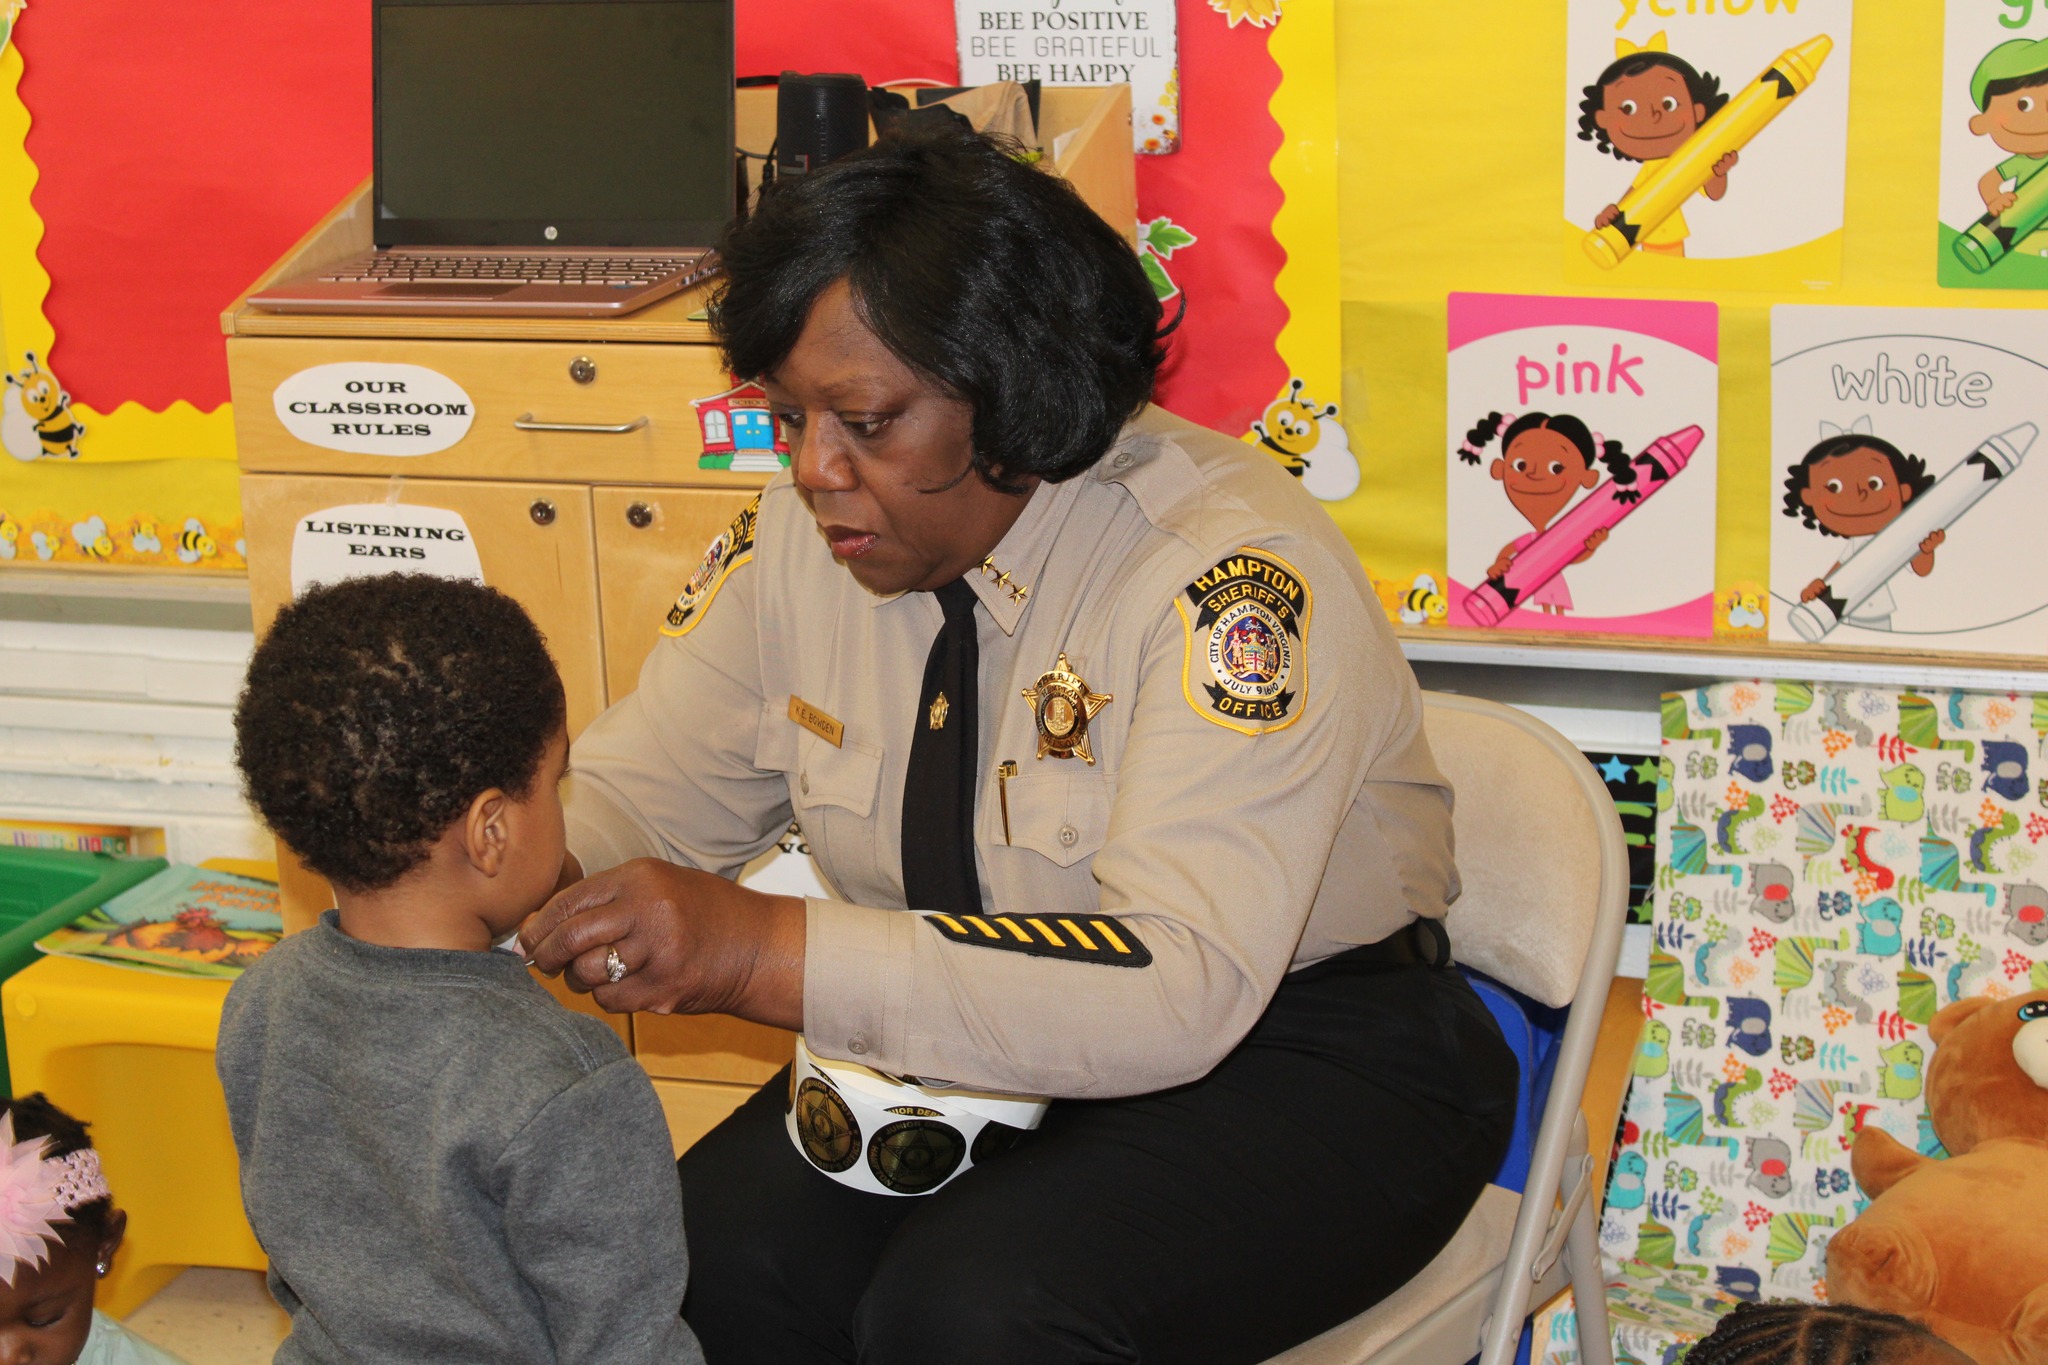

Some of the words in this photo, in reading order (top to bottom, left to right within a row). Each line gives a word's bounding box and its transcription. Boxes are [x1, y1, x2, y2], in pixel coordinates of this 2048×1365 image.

[979, 11, 1024, 30] BEE
[1032, 11, 1149, 30] POSITIVE
[971, 36, 1016, 57] BEE
[1034, 36, 1162, 58] GRATEFUL
[997, 63, 1041, 82] BEE
[1049, 63, 1136, 83] HAPPY
[1515, 342, 1645, 406] pink
[1831, 352, 1993, 408] white
[345, 381, 407, 394] OUR
[289, 402, 469, 416] CLASSROOM
[331, 423, 431, 436] RULES
[305, 521, 466, 542] LISTENING
[348, 544, 426, 560] EARS
[1194, 558, 1300, 601] HAMPTON
[1208, 584, 1290, 619] SHERIFF'S
[1220, 604, 1272, 625] HAMPTON
[1213, 626, 1224, 640] OF
[1209, 641, 1219, 663] CITY
[1271, 621, 1291, 669] VIRGINIA
[1223, 679, 1252, 694] JULY
[1218, 697, 1282, 719] OFFICE
